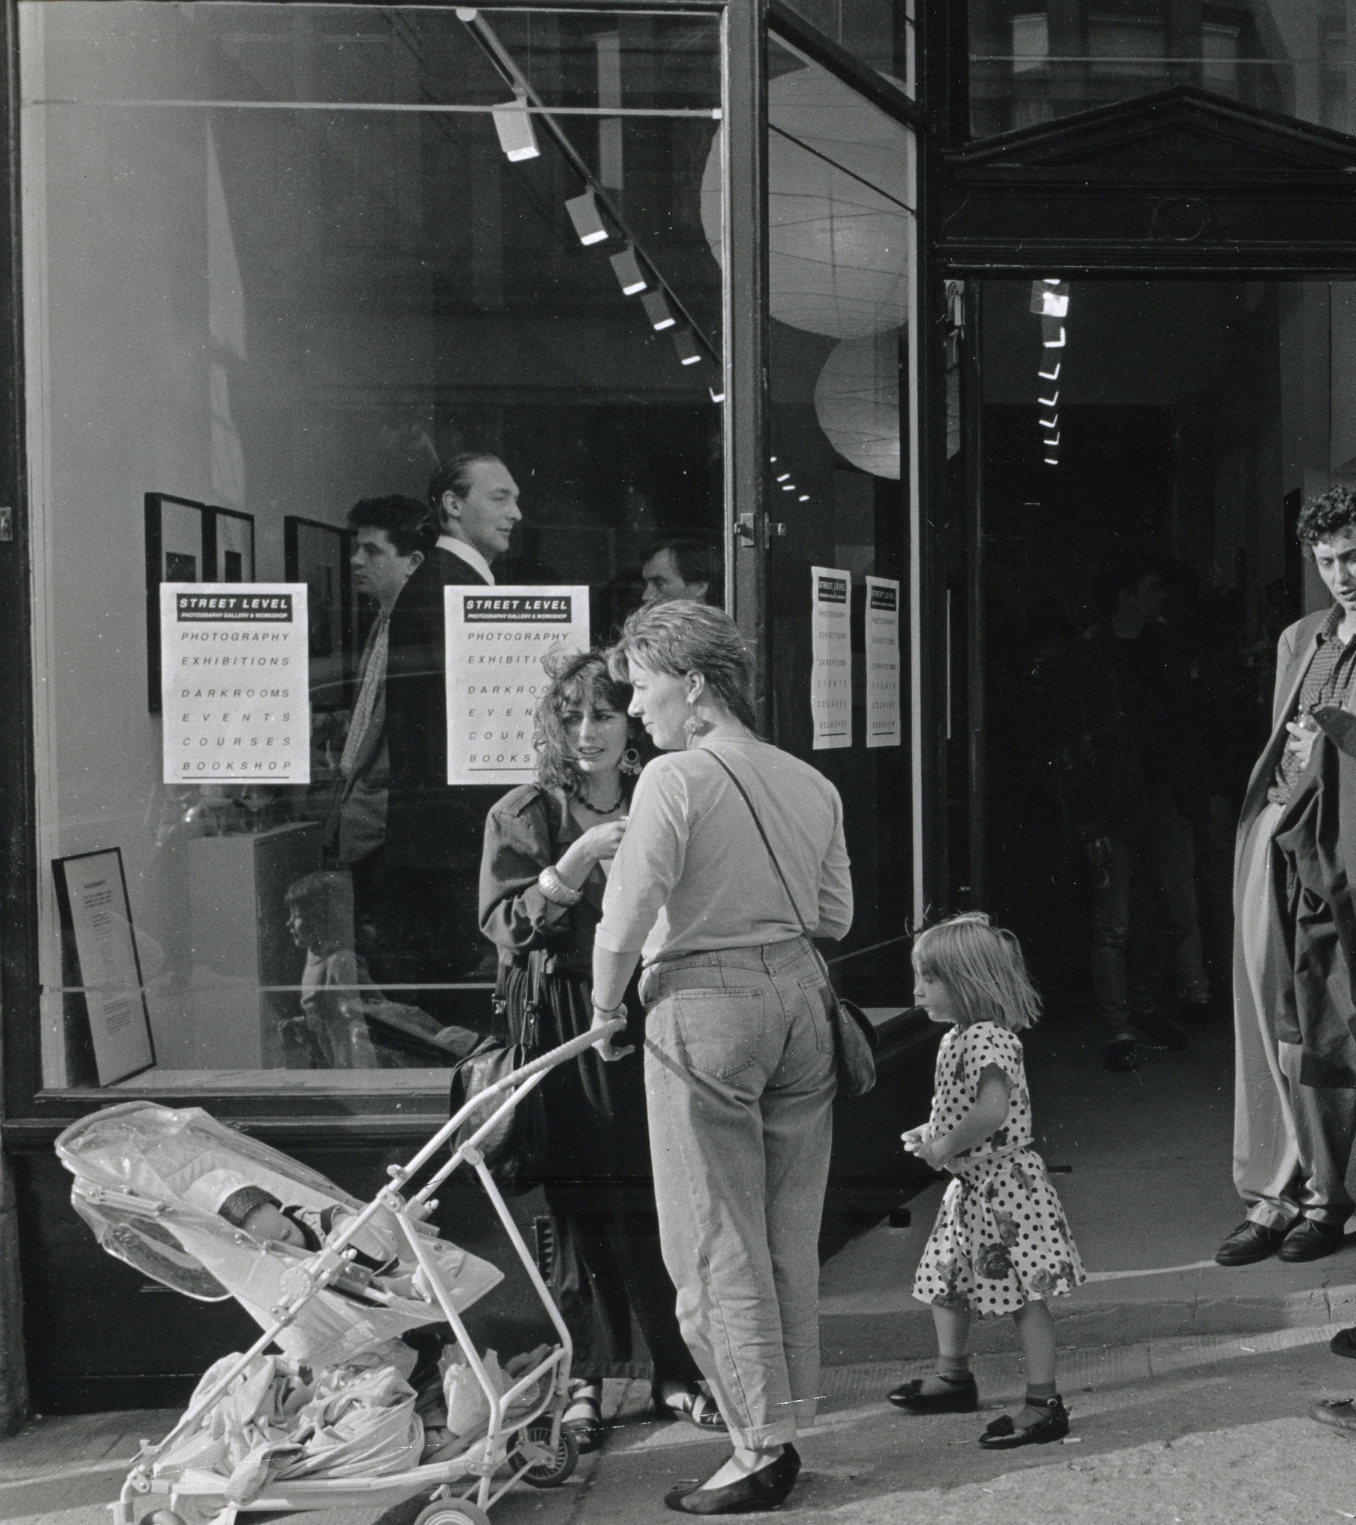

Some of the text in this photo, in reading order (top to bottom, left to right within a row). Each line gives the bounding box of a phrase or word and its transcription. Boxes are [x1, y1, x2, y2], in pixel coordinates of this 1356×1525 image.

[179, 598, 288, 609] STREET LEVEL
[466, 600, 567, 610] STREET LEVEL
[181, 632, 290, 641] PHOTOGRAPHY
[468, 632, 569, 641] PHOTOGRAPHY
[182, 657, 290, 666] EXHIBITIONS
[182, 689, 290, 698] DARKROOMS
[468, 686, 549, 694] DARKROO
[468, 708, 533, 717] EVEN
[182, 713, 290, 722] EVENTS
[182, 737, 291, 746] COURSES
[469, 754, 531, 763] BOOKS
[182, 761, 291, 771] BOOKSHOP
